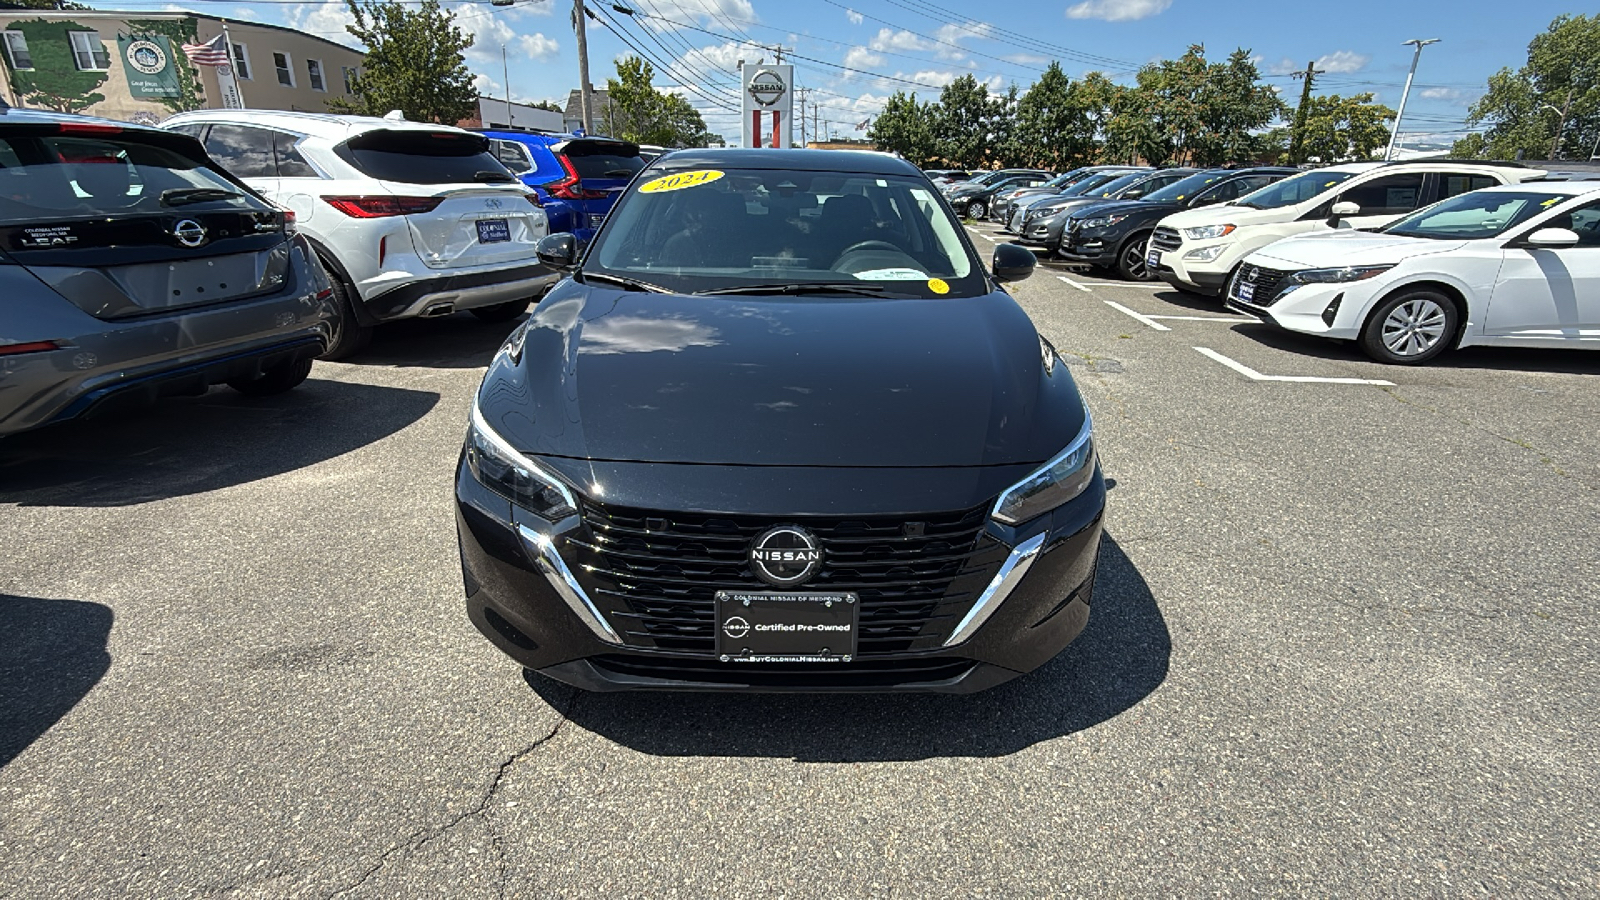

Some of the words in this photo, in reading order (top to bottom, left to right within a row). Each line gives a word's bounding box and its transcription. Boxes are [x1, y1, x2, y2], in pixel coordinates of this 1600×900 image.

[653, 171, 711, 191] 2024
[20, 236, 78, 247] LEAF
[752, 549, 819, 561] NISSAN
[754, 623, 796, 632] Certified
[797, 623, 851, 632] Pre-Owned
